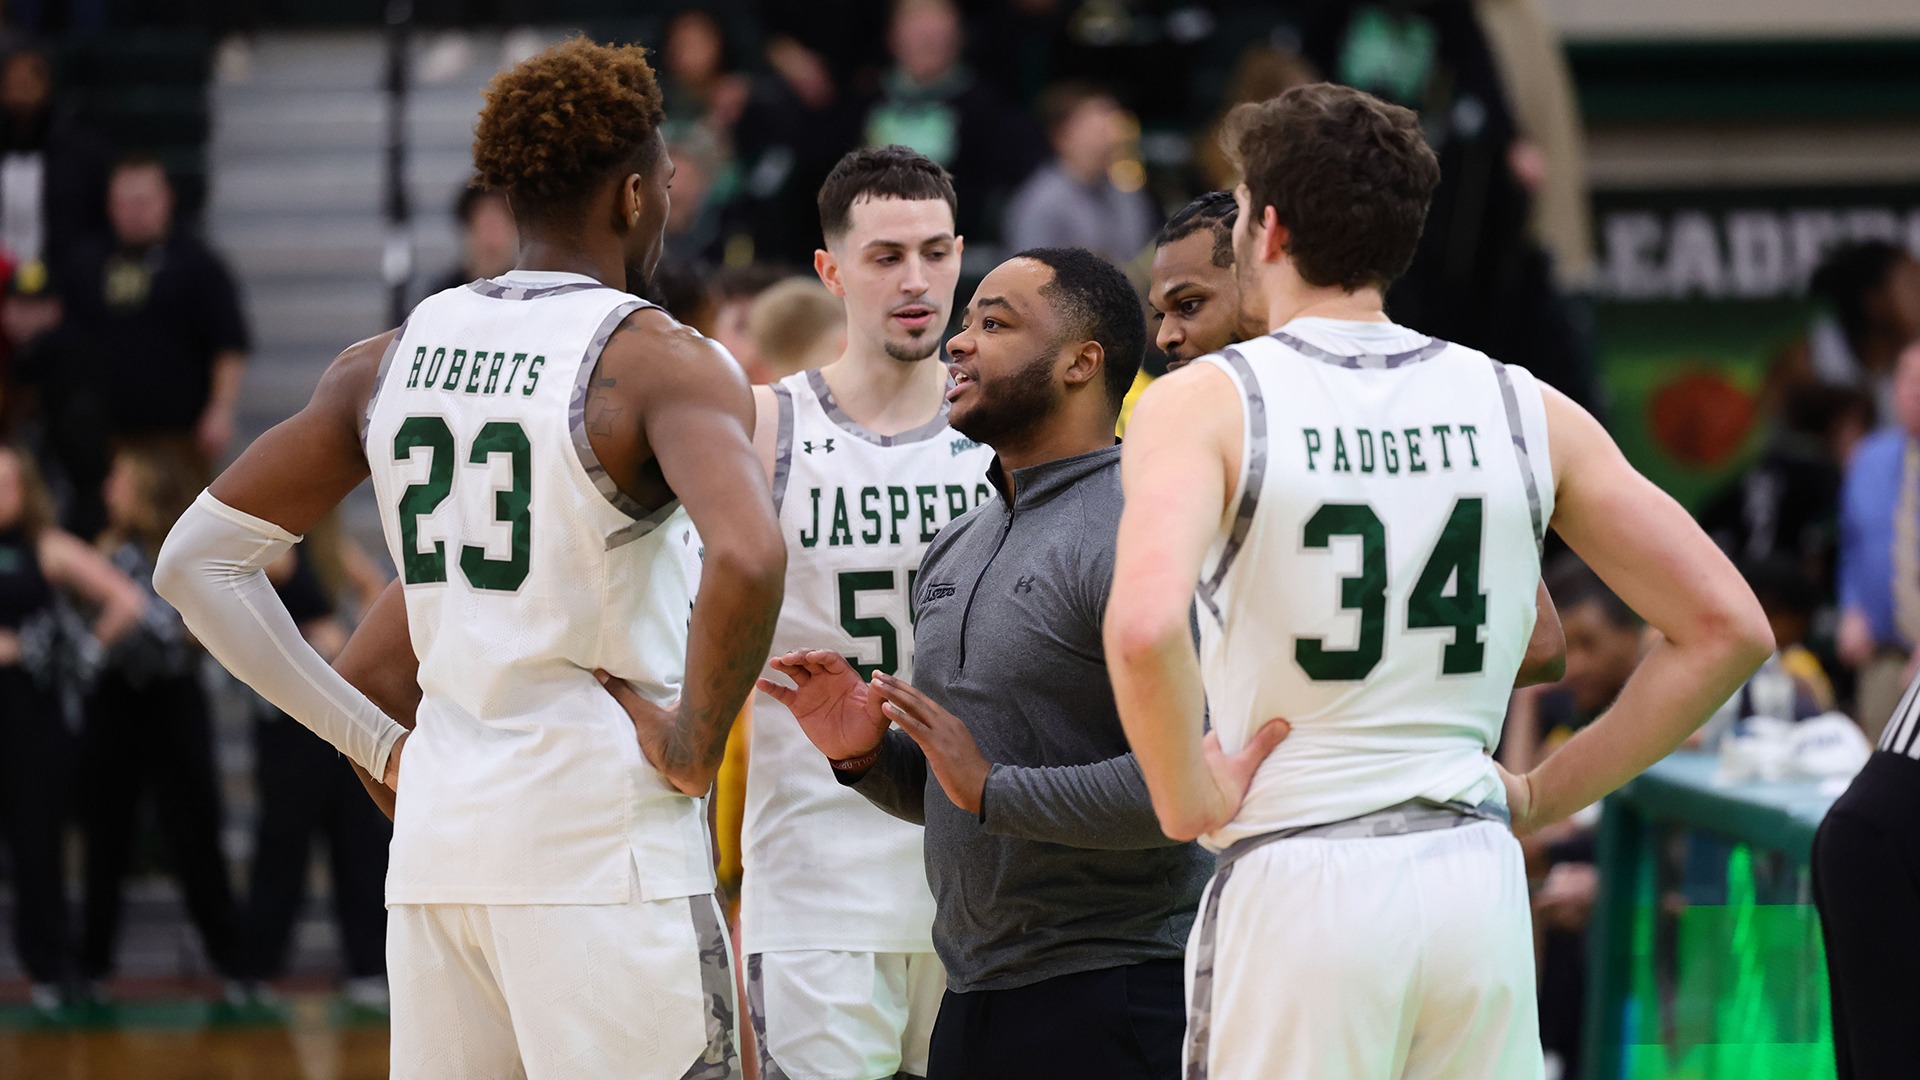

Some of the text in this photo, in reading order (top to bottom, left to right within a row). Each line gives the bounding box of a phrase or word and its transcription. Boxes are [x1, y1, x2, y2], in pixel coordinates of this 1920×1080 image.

[406, 346, 545, 396] ROBERTS
[393, 416, 532, 592] 23
[1303, 424, 1479, 473] PADGETT
[838, 570, 918, 684] 5
[1295, 498, 1487, 680] 34
